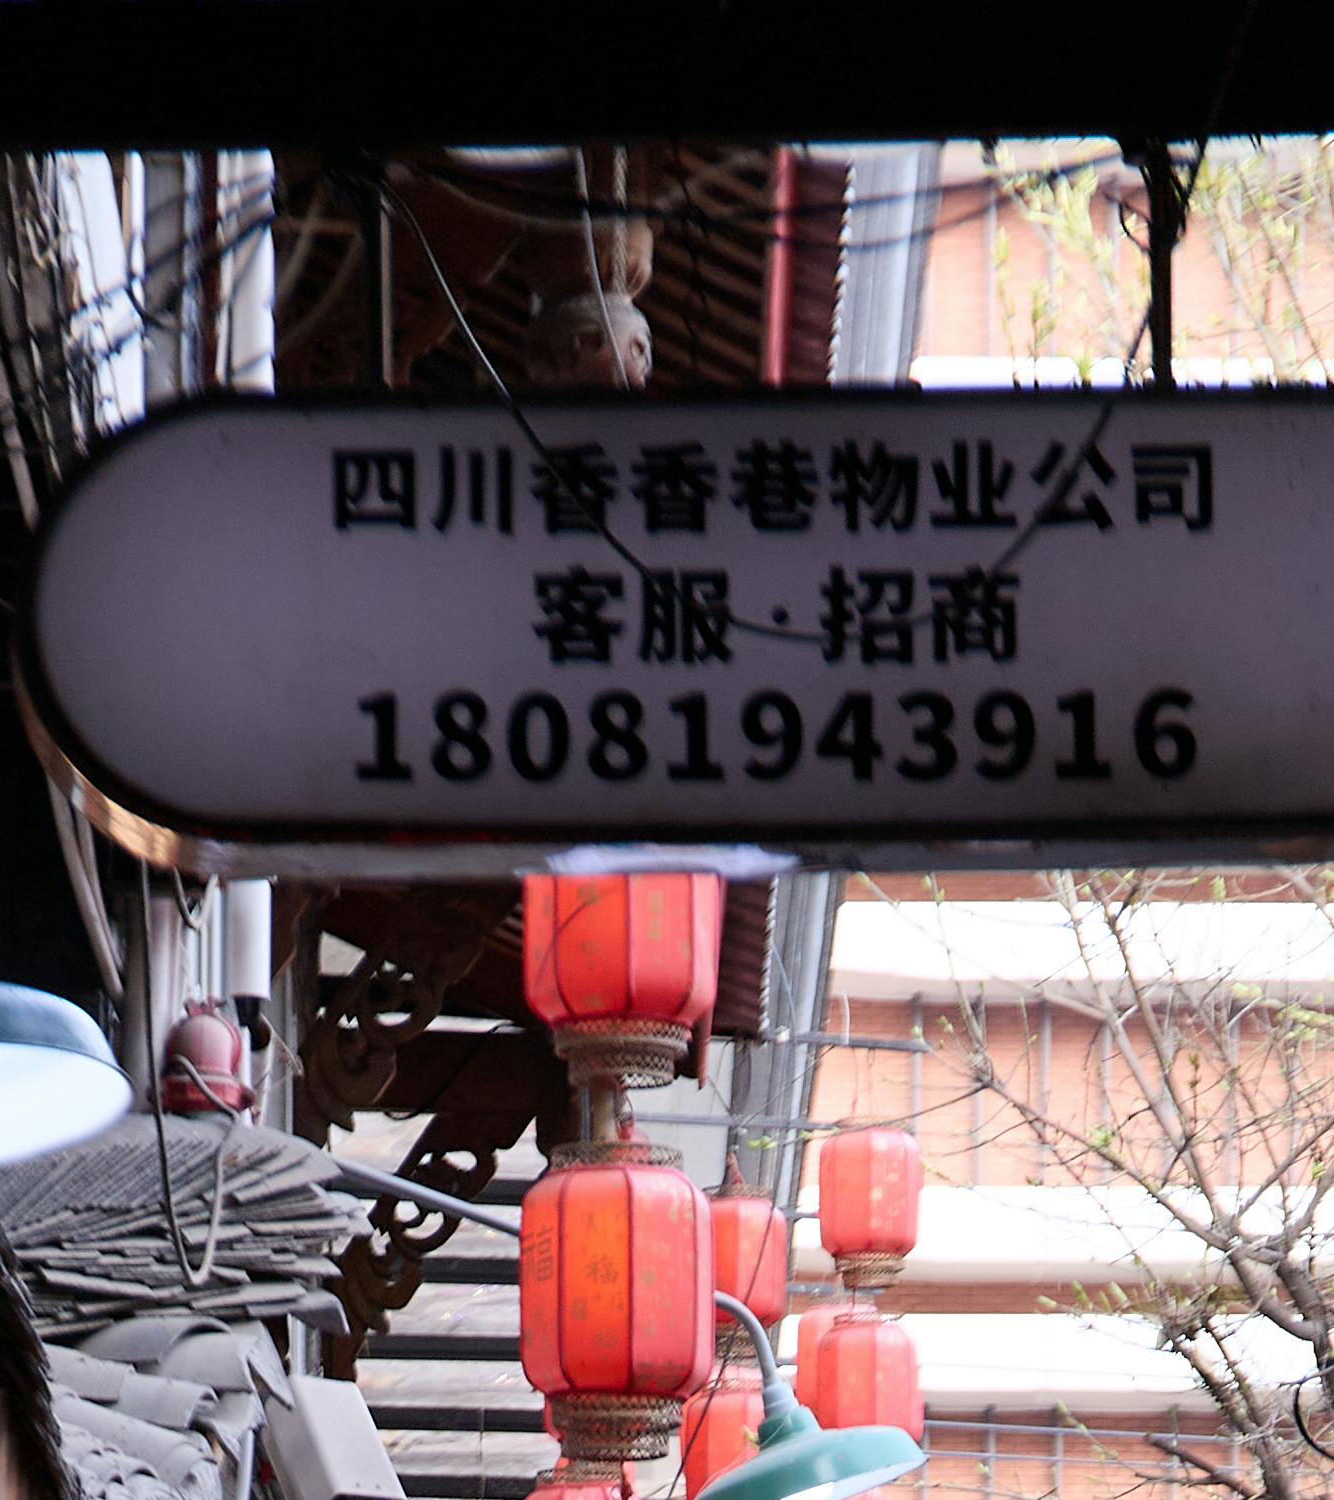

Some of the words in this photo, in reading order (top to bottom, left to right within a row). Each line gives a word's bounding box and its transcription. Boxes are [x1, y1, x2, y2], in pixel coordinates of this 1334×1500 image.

[331, 440, 1218, 534] 四川香香巷物业公司
[532, 566, 1024, 666] 客服·招商
[354, 688, 1200, 783] 18081943916
